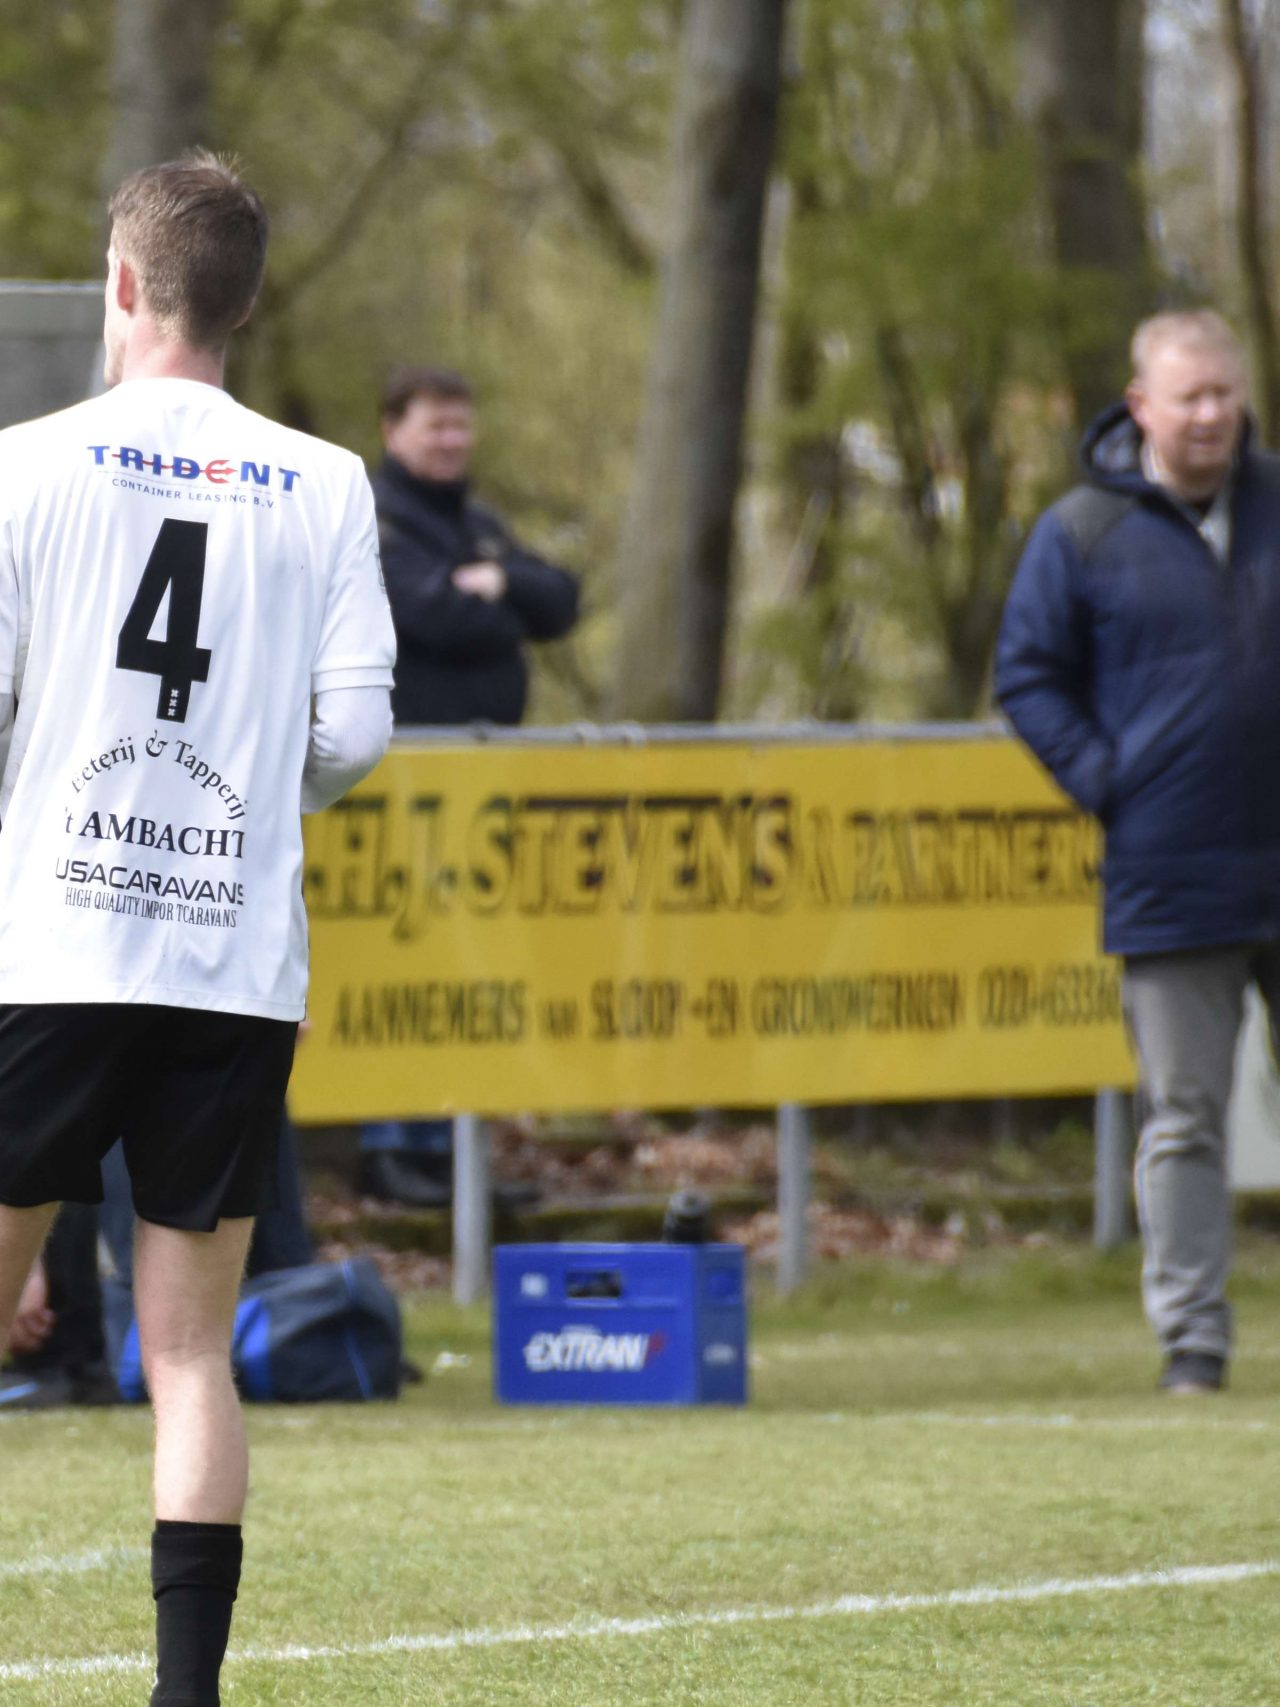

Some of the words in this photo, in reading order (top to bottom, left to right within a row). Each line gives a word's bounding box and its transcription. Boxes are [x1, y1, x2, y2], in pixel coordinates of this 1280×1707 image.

[87, 445, 301, 492] TRIDENT
[111, 478, 182, 500] CONTAINER
[188, 491, 247, 505] LEASING
[116, 518, 212, 723] 4
[145, 729, 169, 758] &
[173, 739, 246, 820] Tapperij
[65, 887, 92, 909] HIGH
[94, 891, 140, 915] QUALITY
